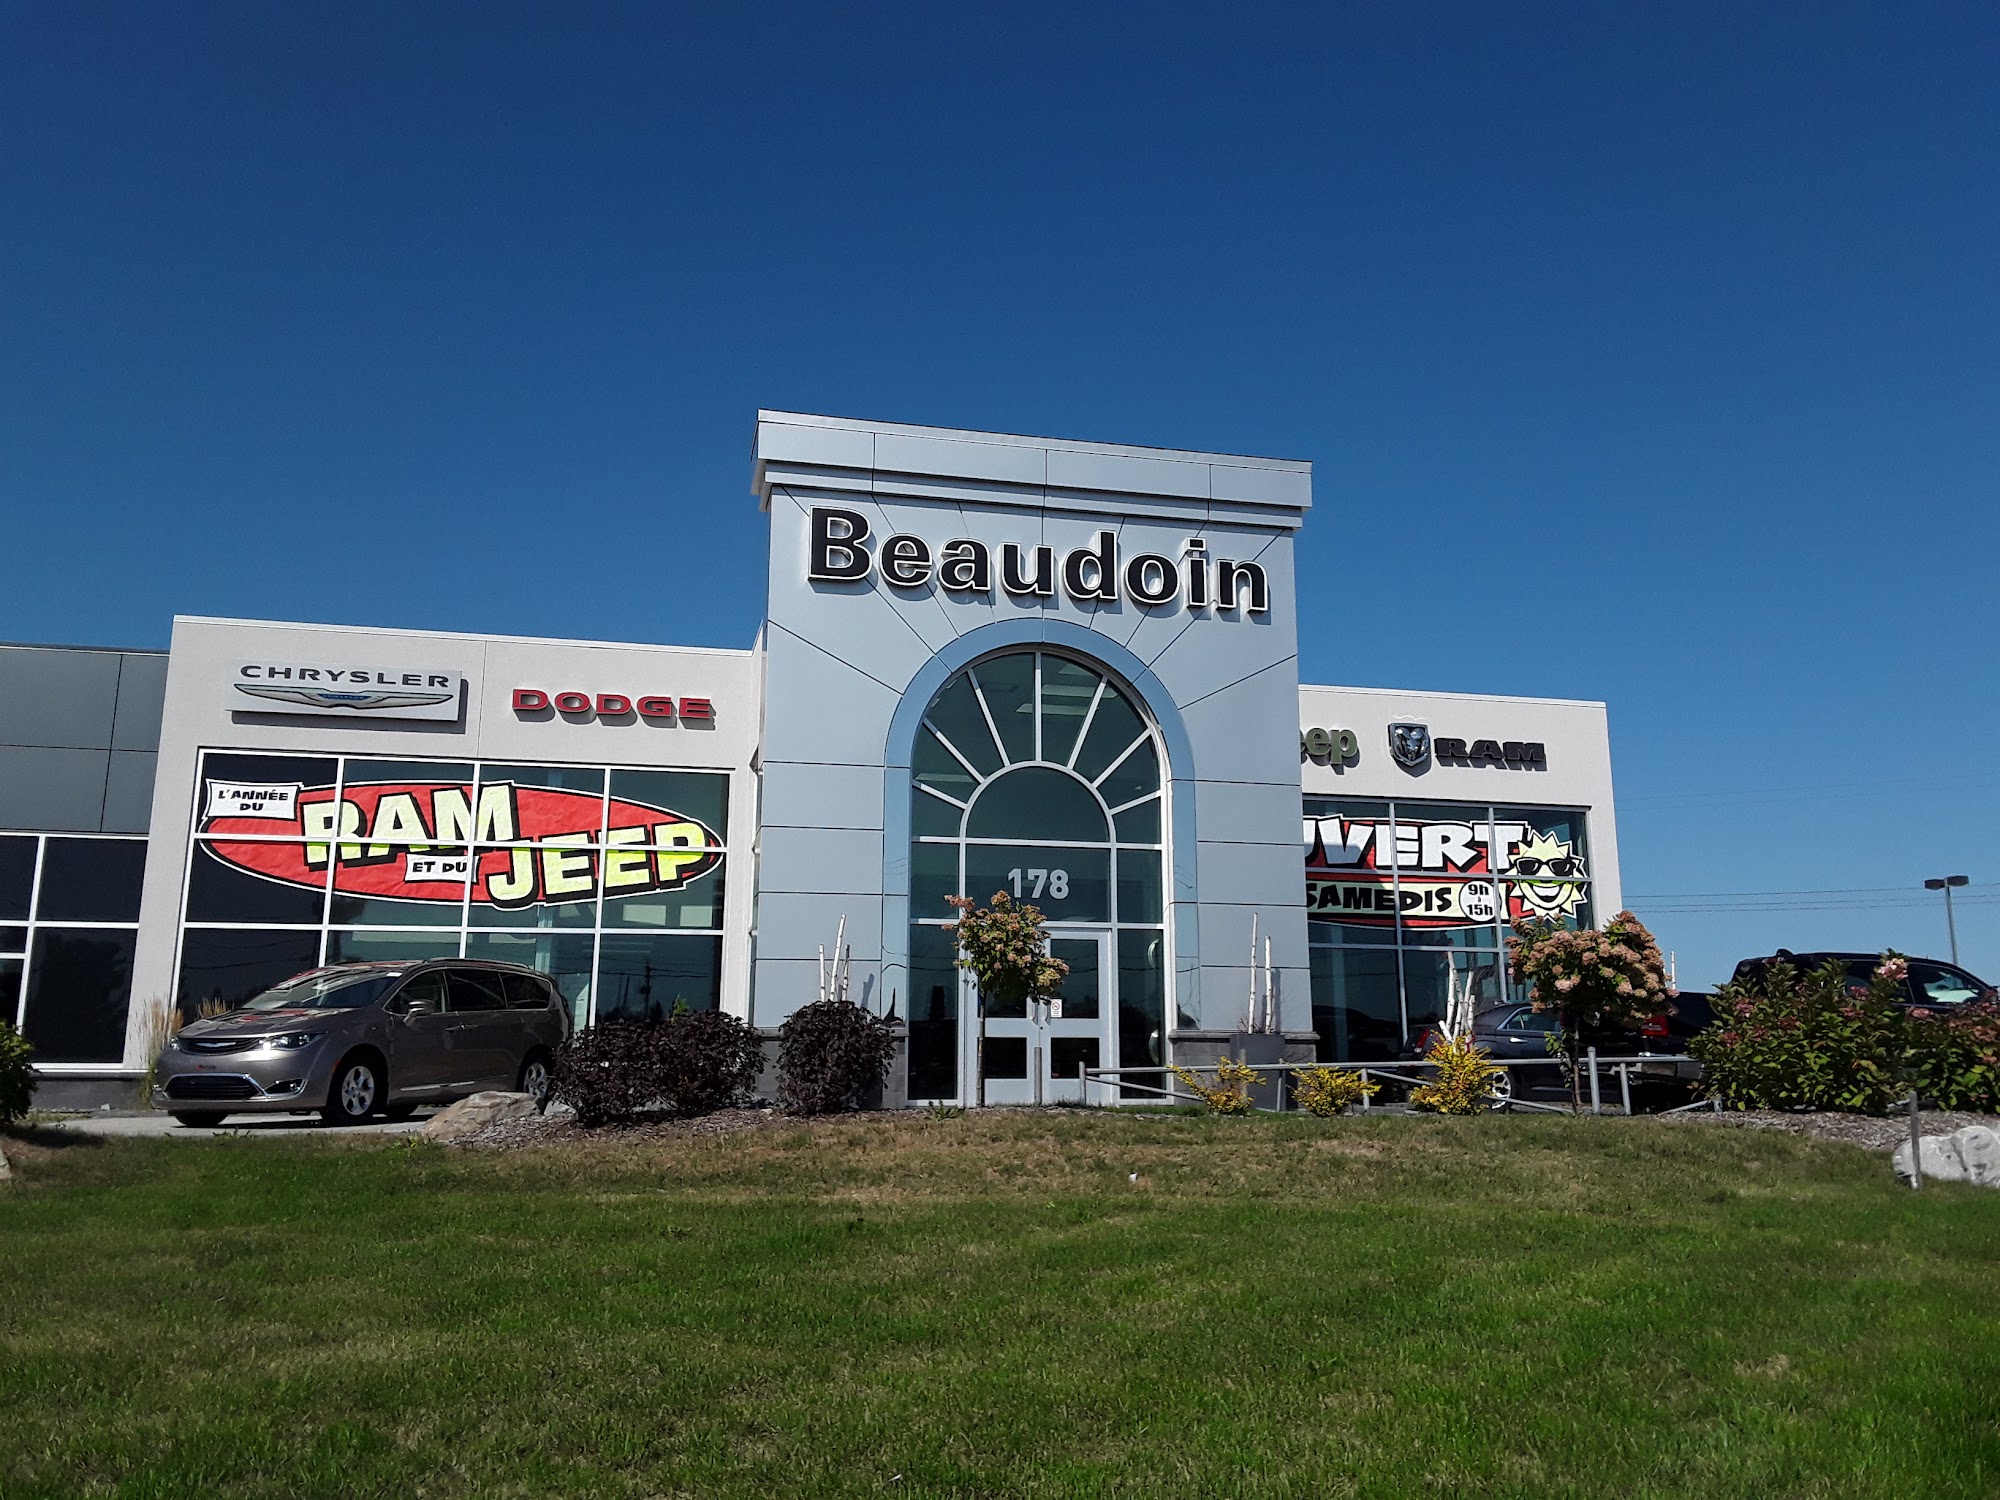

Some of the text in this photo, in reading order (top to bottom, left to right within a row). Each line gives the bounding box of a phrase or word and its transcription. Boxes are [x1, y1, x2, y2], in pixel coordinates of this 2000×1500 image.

[808, 505, 1268, 612] Beaudoin
[240, 665, 450, 687] CHRYSLER
[512, 689, 711, 718] DODGE
[1299, 727, 1358, 764] ep
[1434, 738, 1545, 761] RAM
[218, 789, 289, 801] L'ANNÉE
[239, 802, 264, 811] DU
[303, 784, 513, 863] RAM
[413, 861, 468, 873] ET DU
[488, 823, 706, 901] JEEP
[1007, 868, 1069, 899] 178
[1468, 884, 1489, 895] 9h
[1466, 904, 1493, 916] 15h
